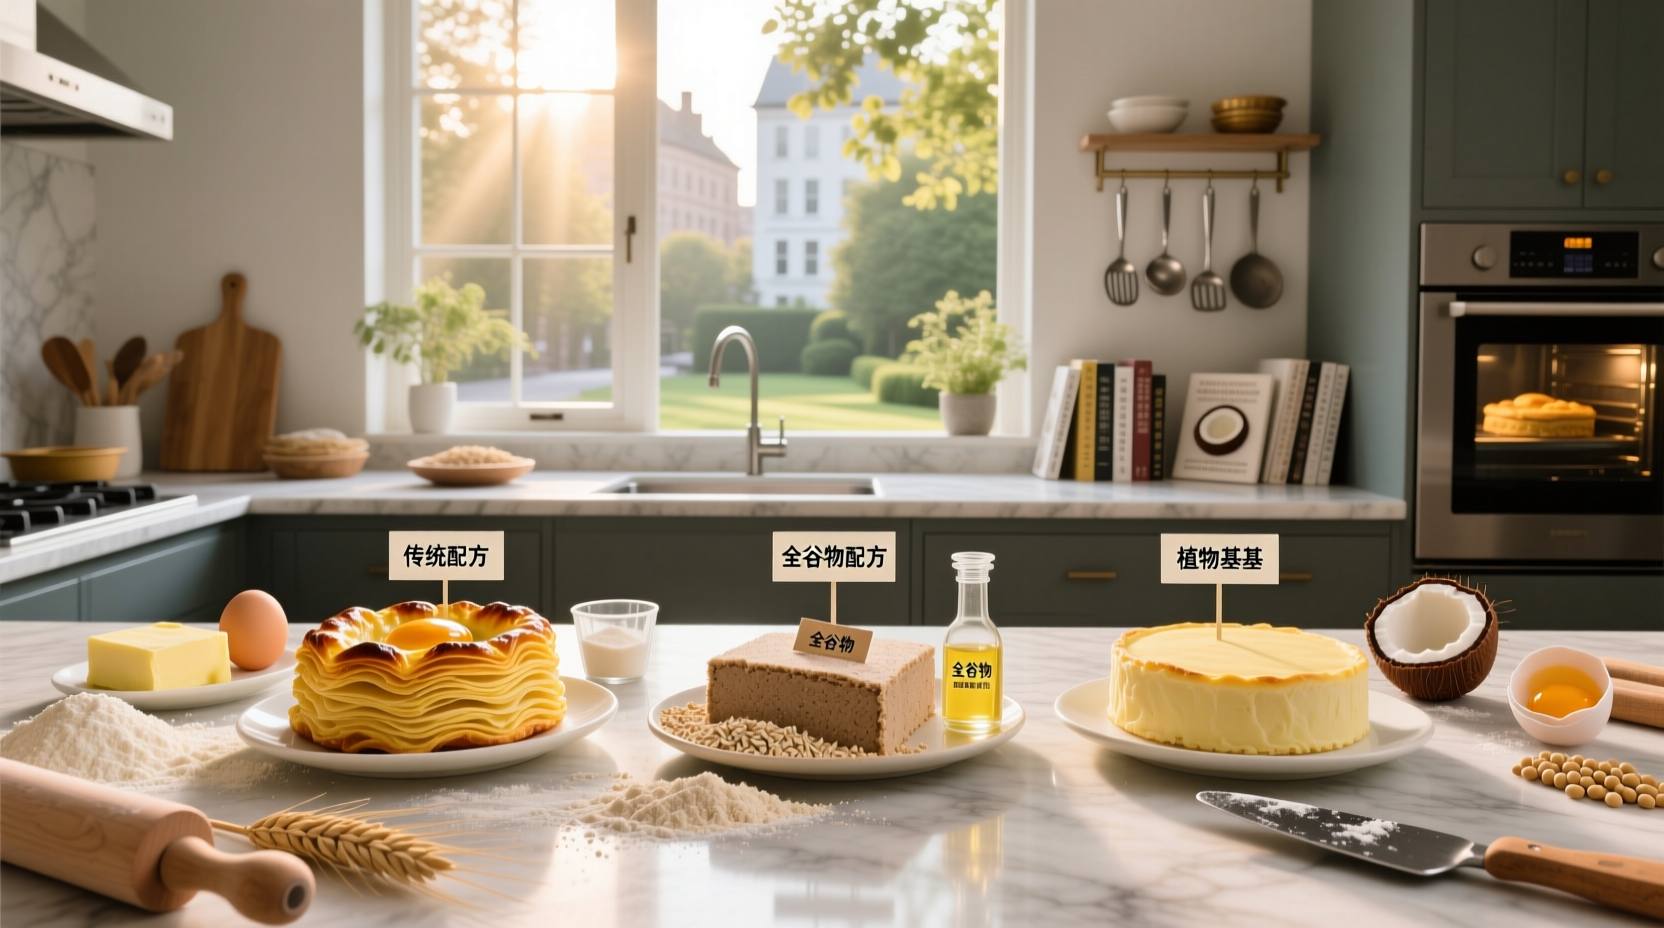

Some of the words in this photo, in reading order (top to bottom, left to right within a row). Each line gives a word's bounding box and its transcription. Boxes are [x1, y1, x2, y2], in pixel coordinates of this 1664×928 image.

[403, 543, 489, 568] 传统配方
[781, 544, 888, 568] 全谷物配方
[1176, 545, 1264, 570] 植物基基
[808, 630, 855, 654] 全谷物
[952, 661, 992, 679] 全谷物
